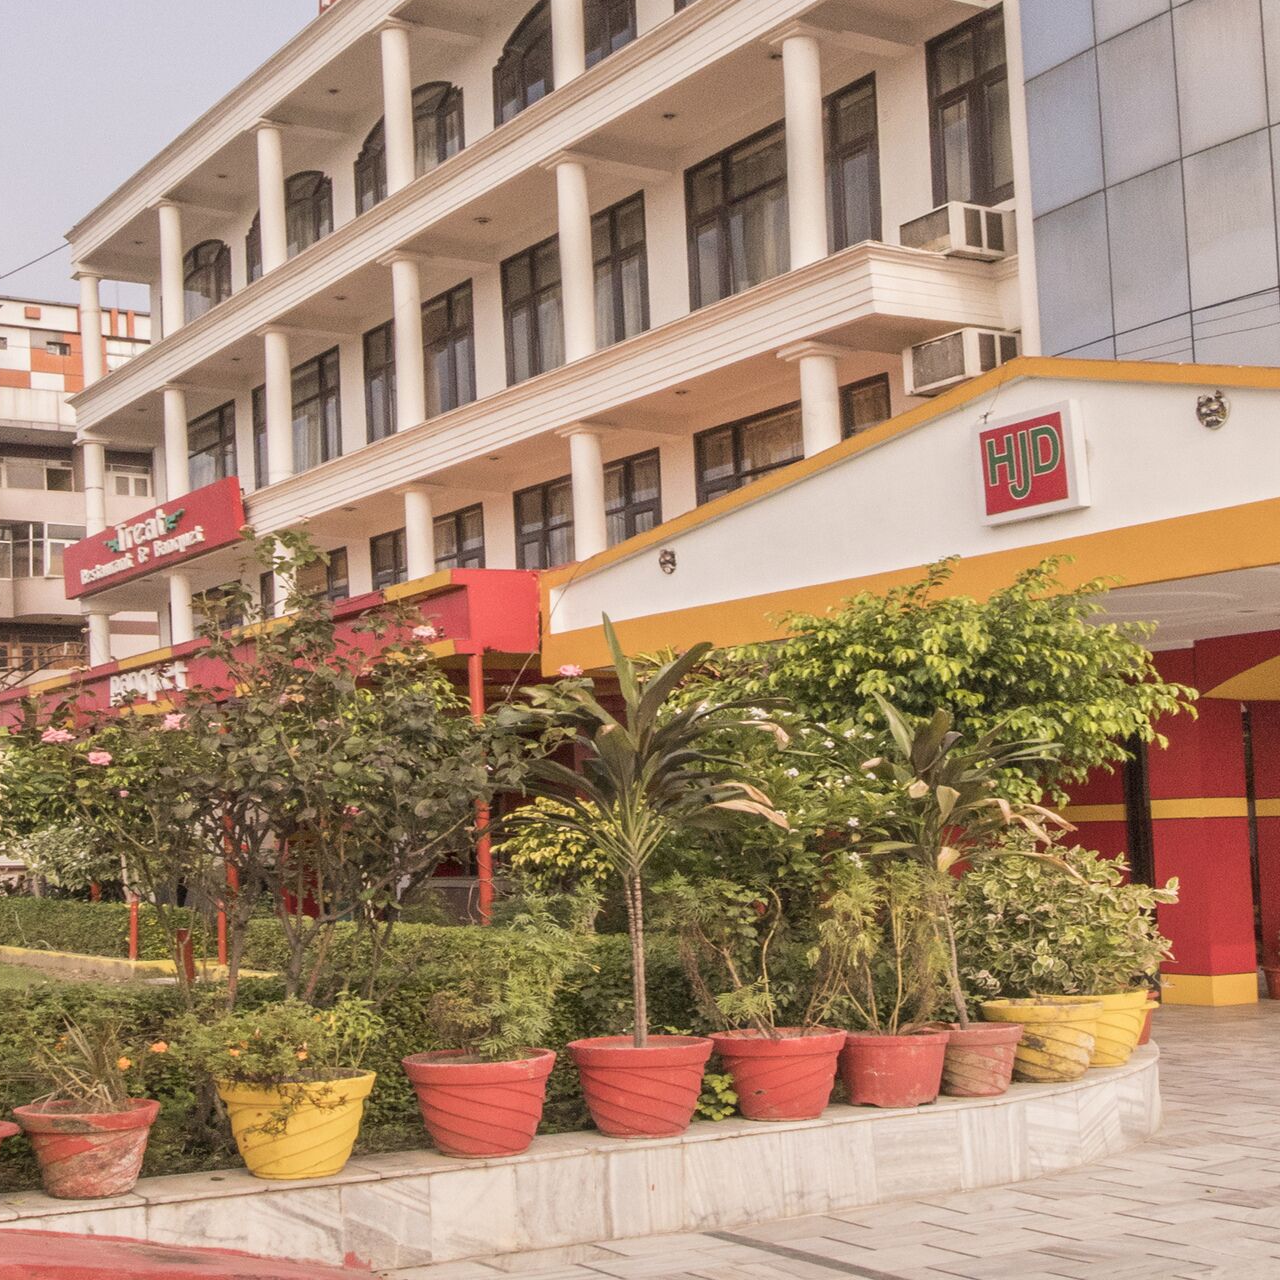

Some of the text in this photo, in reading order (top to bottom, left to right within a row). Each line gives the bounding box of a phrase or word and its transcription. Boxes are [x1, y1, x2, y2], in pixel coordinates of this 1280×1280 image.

[986, 425, 1061, 500] HJD
[115, 508, 167, 551] Treat
[137, 547, 150, 563] &
